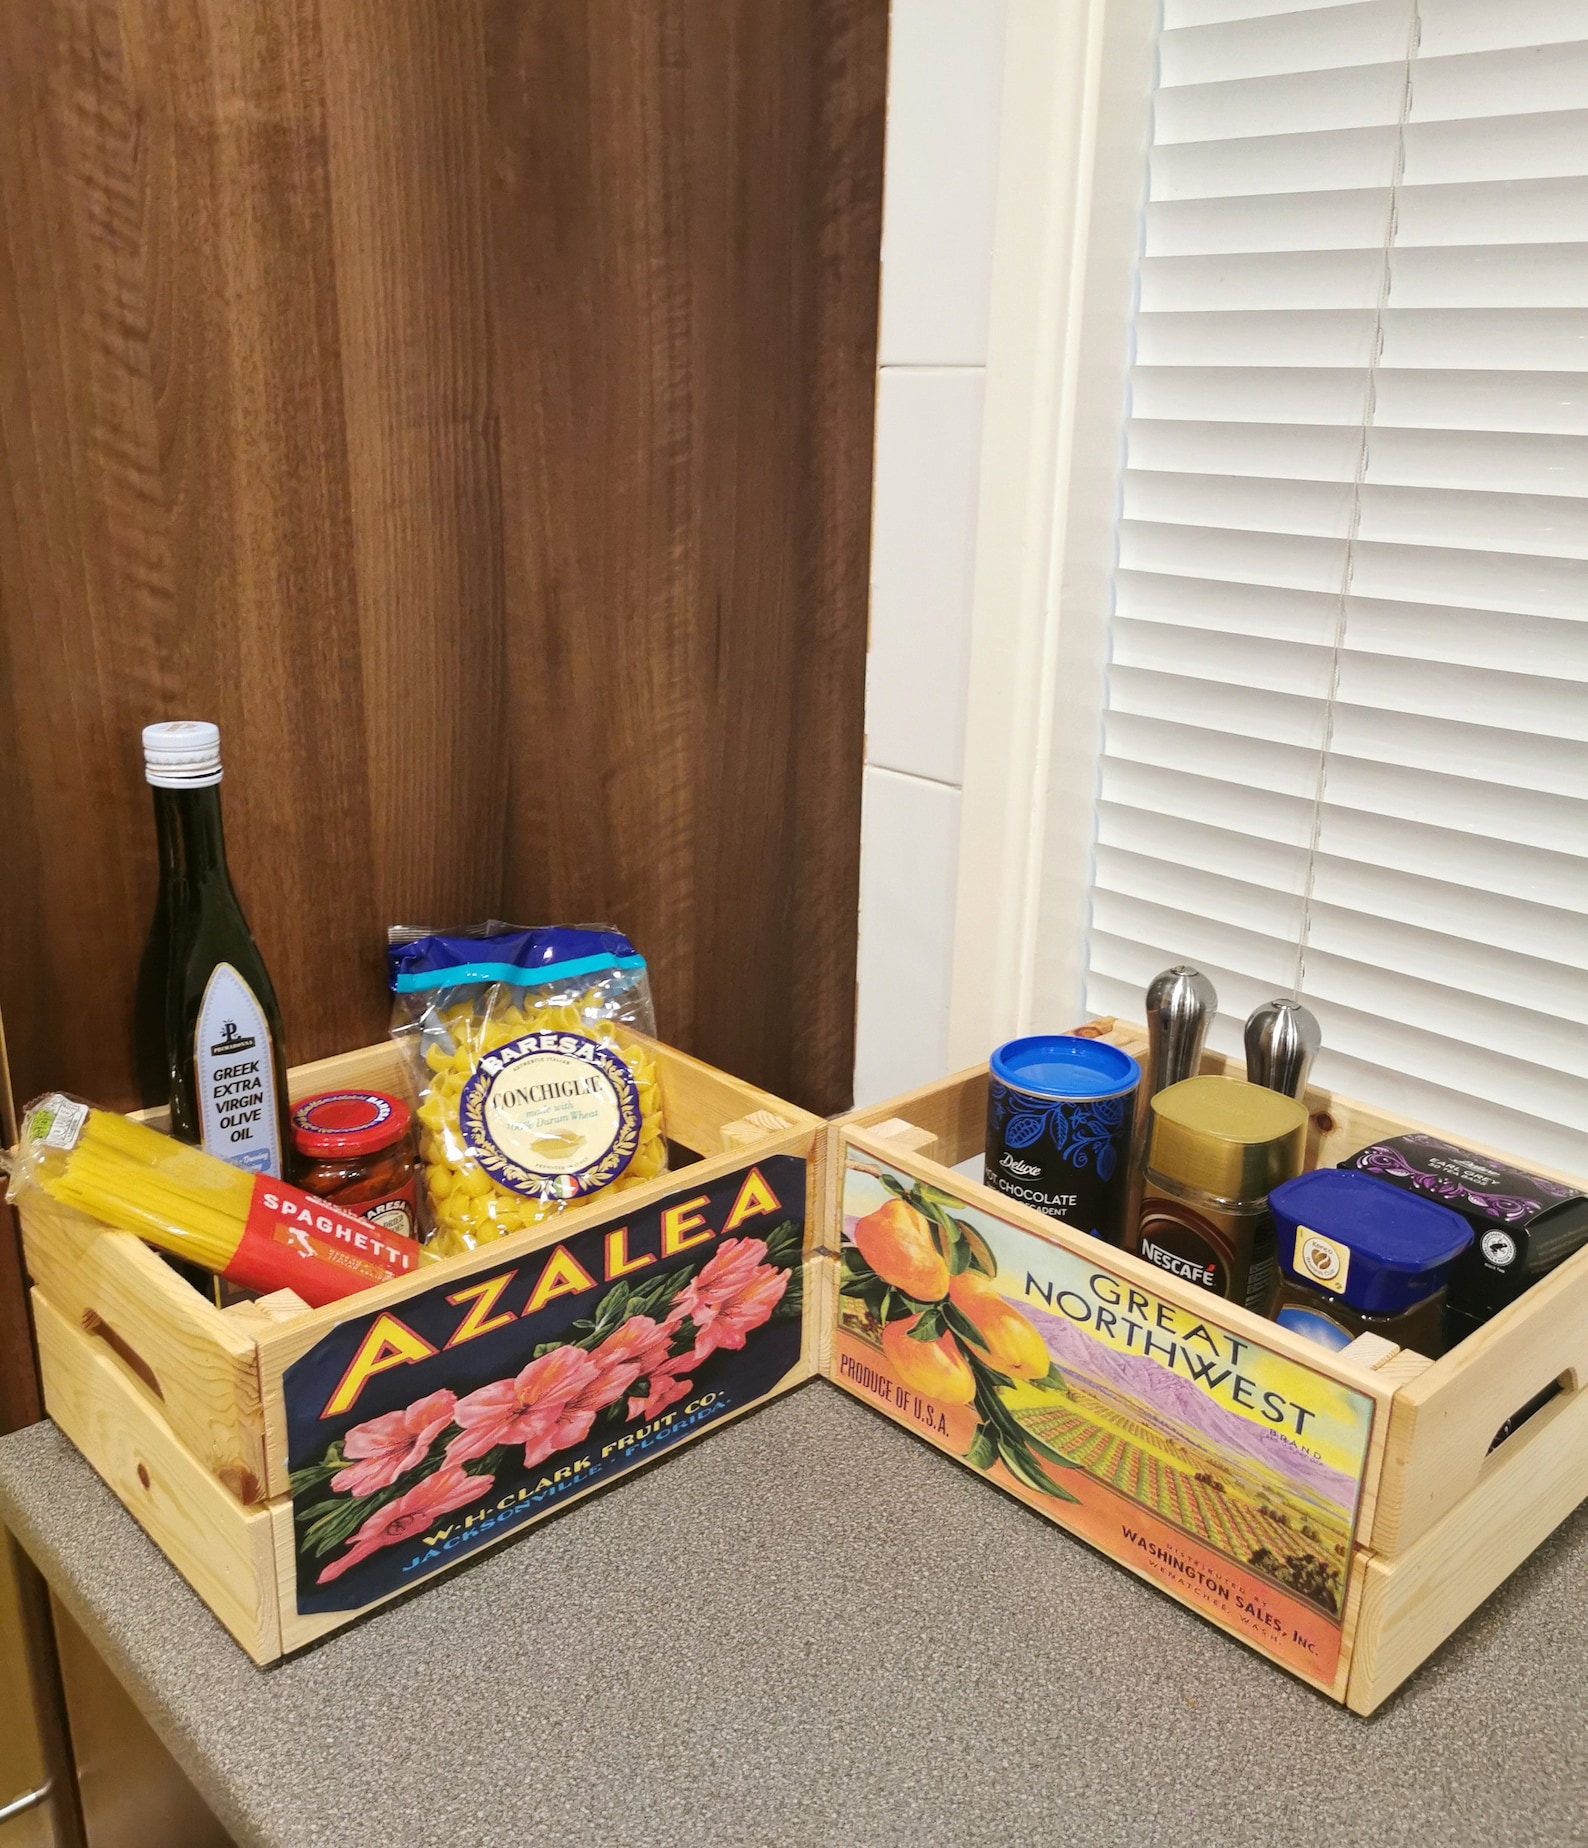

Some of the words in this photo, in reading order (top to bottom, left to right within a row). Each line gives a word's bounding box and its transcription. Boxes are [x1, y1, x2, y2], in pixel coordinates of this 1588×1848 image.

[480, 1035, 597, 1076] BARESA
[513, 1057, 545, 1072] AUTHENTIC
[546, 1057, 571, 1065] ITALIAN
[213, 1060, 260, 1082] GREEK
[213, 1077, 262, 1098] EXTRA
[215, 1092, 263, 1114] VIRGIN
[554, 1101, 575, 1112] with
[220, 1108, 262, 1129] OLIVE
[536, 1115, 568, 1128] Durum
[570, 1110, 599, 1120] Wheat
[230, 1127, 254, 1143] OIL
[999, 1151, 1042, 1177] Deluxe
[1429, 1157, 1461, 1173] EARL
[1464, 1169, 1501, 1185] GREY
[1442, 1167, 1460, 1176] TEA
[1460, 1174, 1488, 1186] BAGS
[998, 1178, 1078, 1206] CHOCOLATE
[366, 1200, 406, 1221] ARESA
[1019, 1201, 1068, 1216] CADENT
[263, 1193, 409, 1269] SPAGHETTI
[1142, 1238, 1217, 1287] NESCAFÉ
[319, 1166, 782, 1420] AZALEA
[1088, 1273, 1248, 1366] GREAT
[1025, 1271, 1315, 1435] NORTHWEST
[840, 1353, 893, 1403] PRODUCE
[895, 1386, 911, 1411] OF
[914, 1397, 949, 1438] U.S.A.
[601, 1411, 677, 1458] FRUIT
[1269, 1428, 1322, 1460] BRAND
[402, 1463, 603, 1572] JACKSONVILLE
[1166, 1543, 1246, 1595] DISTRIBUTED
[1253, 1596, 1267, 1608] BY
[1121, 1525, 1230, 1600] WASHINGTON
[1235, 1595, 1288, 1637] SALES,
[1291, 1630, 1319, 1656] INC.
[1239, 1614, 1282, 1646] WASH.
